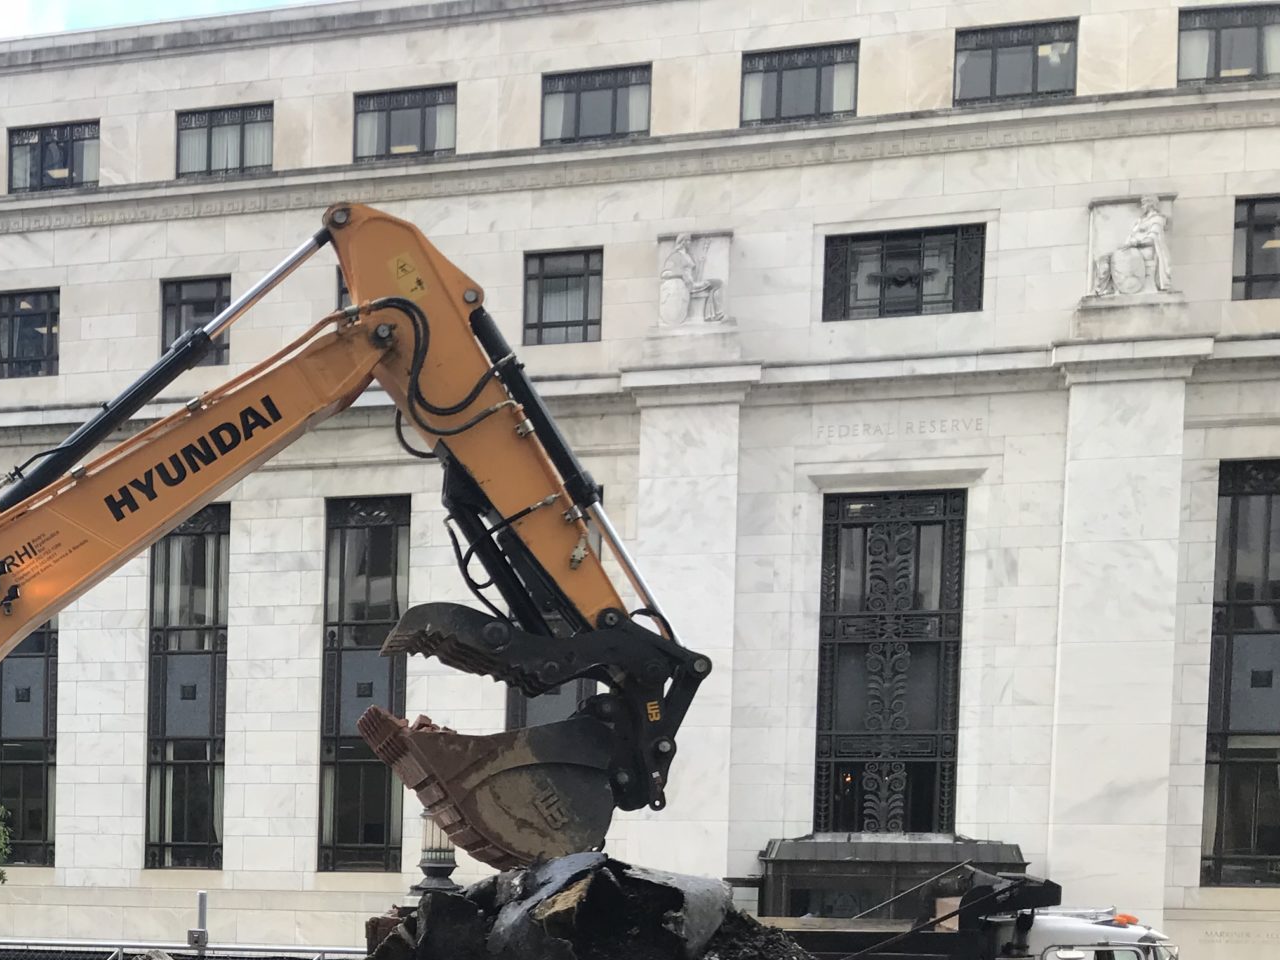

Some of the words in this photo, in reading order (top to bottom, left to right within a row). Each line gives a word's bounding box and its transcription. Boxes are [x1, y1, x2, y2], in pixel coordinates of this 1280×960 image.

[816, 423, 895, 438] FEDERAL
[905, 418, 984, 434] RESERVE
[104, 395, 282, 522] HYUNDAI
[6, 542, 37, 573] RHI
